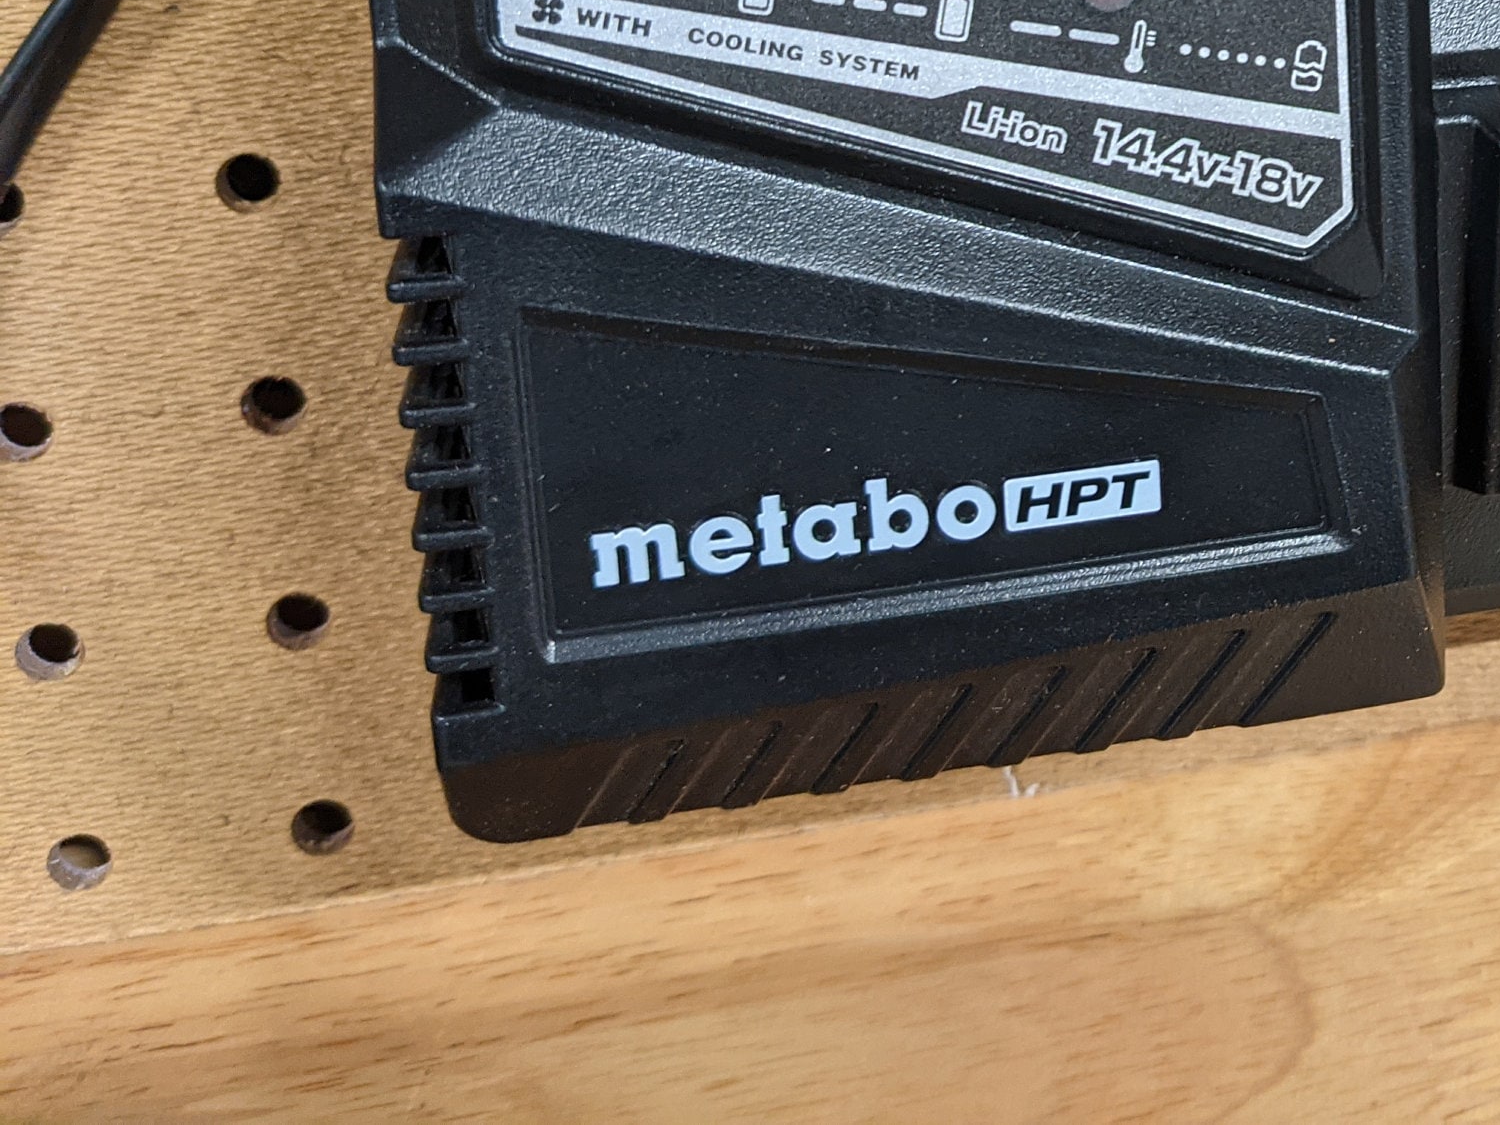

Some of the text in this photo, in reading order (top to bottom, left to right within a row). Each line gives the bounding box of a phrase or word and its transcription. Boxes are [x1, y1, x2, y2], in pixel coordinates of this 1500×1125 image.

[577, 7, 921, 81] WITH COOLING SYSTEM
[961, 100, 1068, 154] Li-ion
[590, 468, 1153, 589] metabo HPT
